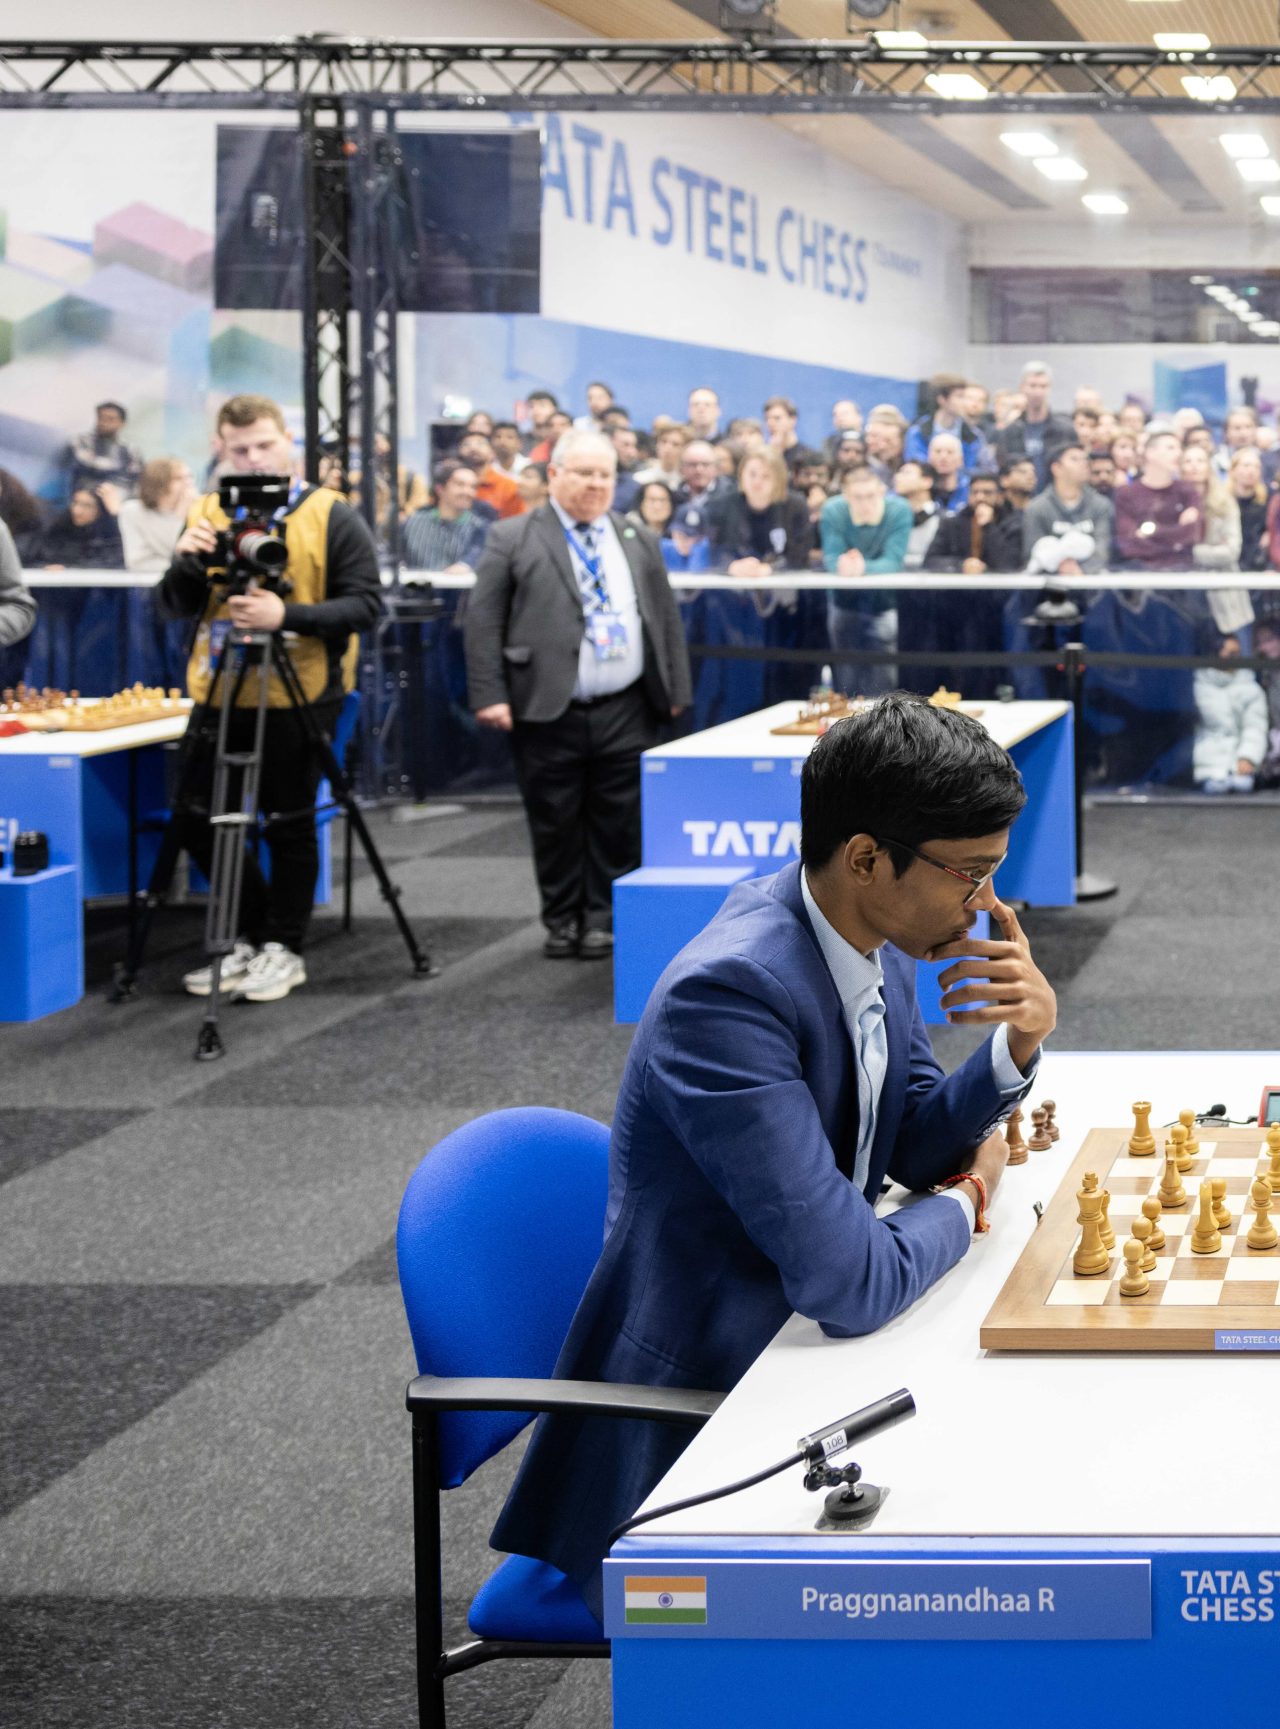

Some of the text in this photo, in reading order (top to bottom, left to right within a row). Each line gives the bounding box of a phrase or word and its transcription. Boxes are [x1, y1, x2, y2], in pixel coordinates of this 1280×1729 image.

[506, 112, 868, 304] ATA STEEL CHESS
[1221, 1336, 1241, 1344] TATA
[1243, 1336, 1267, 1344] STEEL
[827, 1436, 844, 1450] 108
[1180, 1570, 1252, 1595] TATA
[801, 1587, 1056, 1619] Praggnanandhaa R
[1180, 1597, 1275, 1622] CHESS
